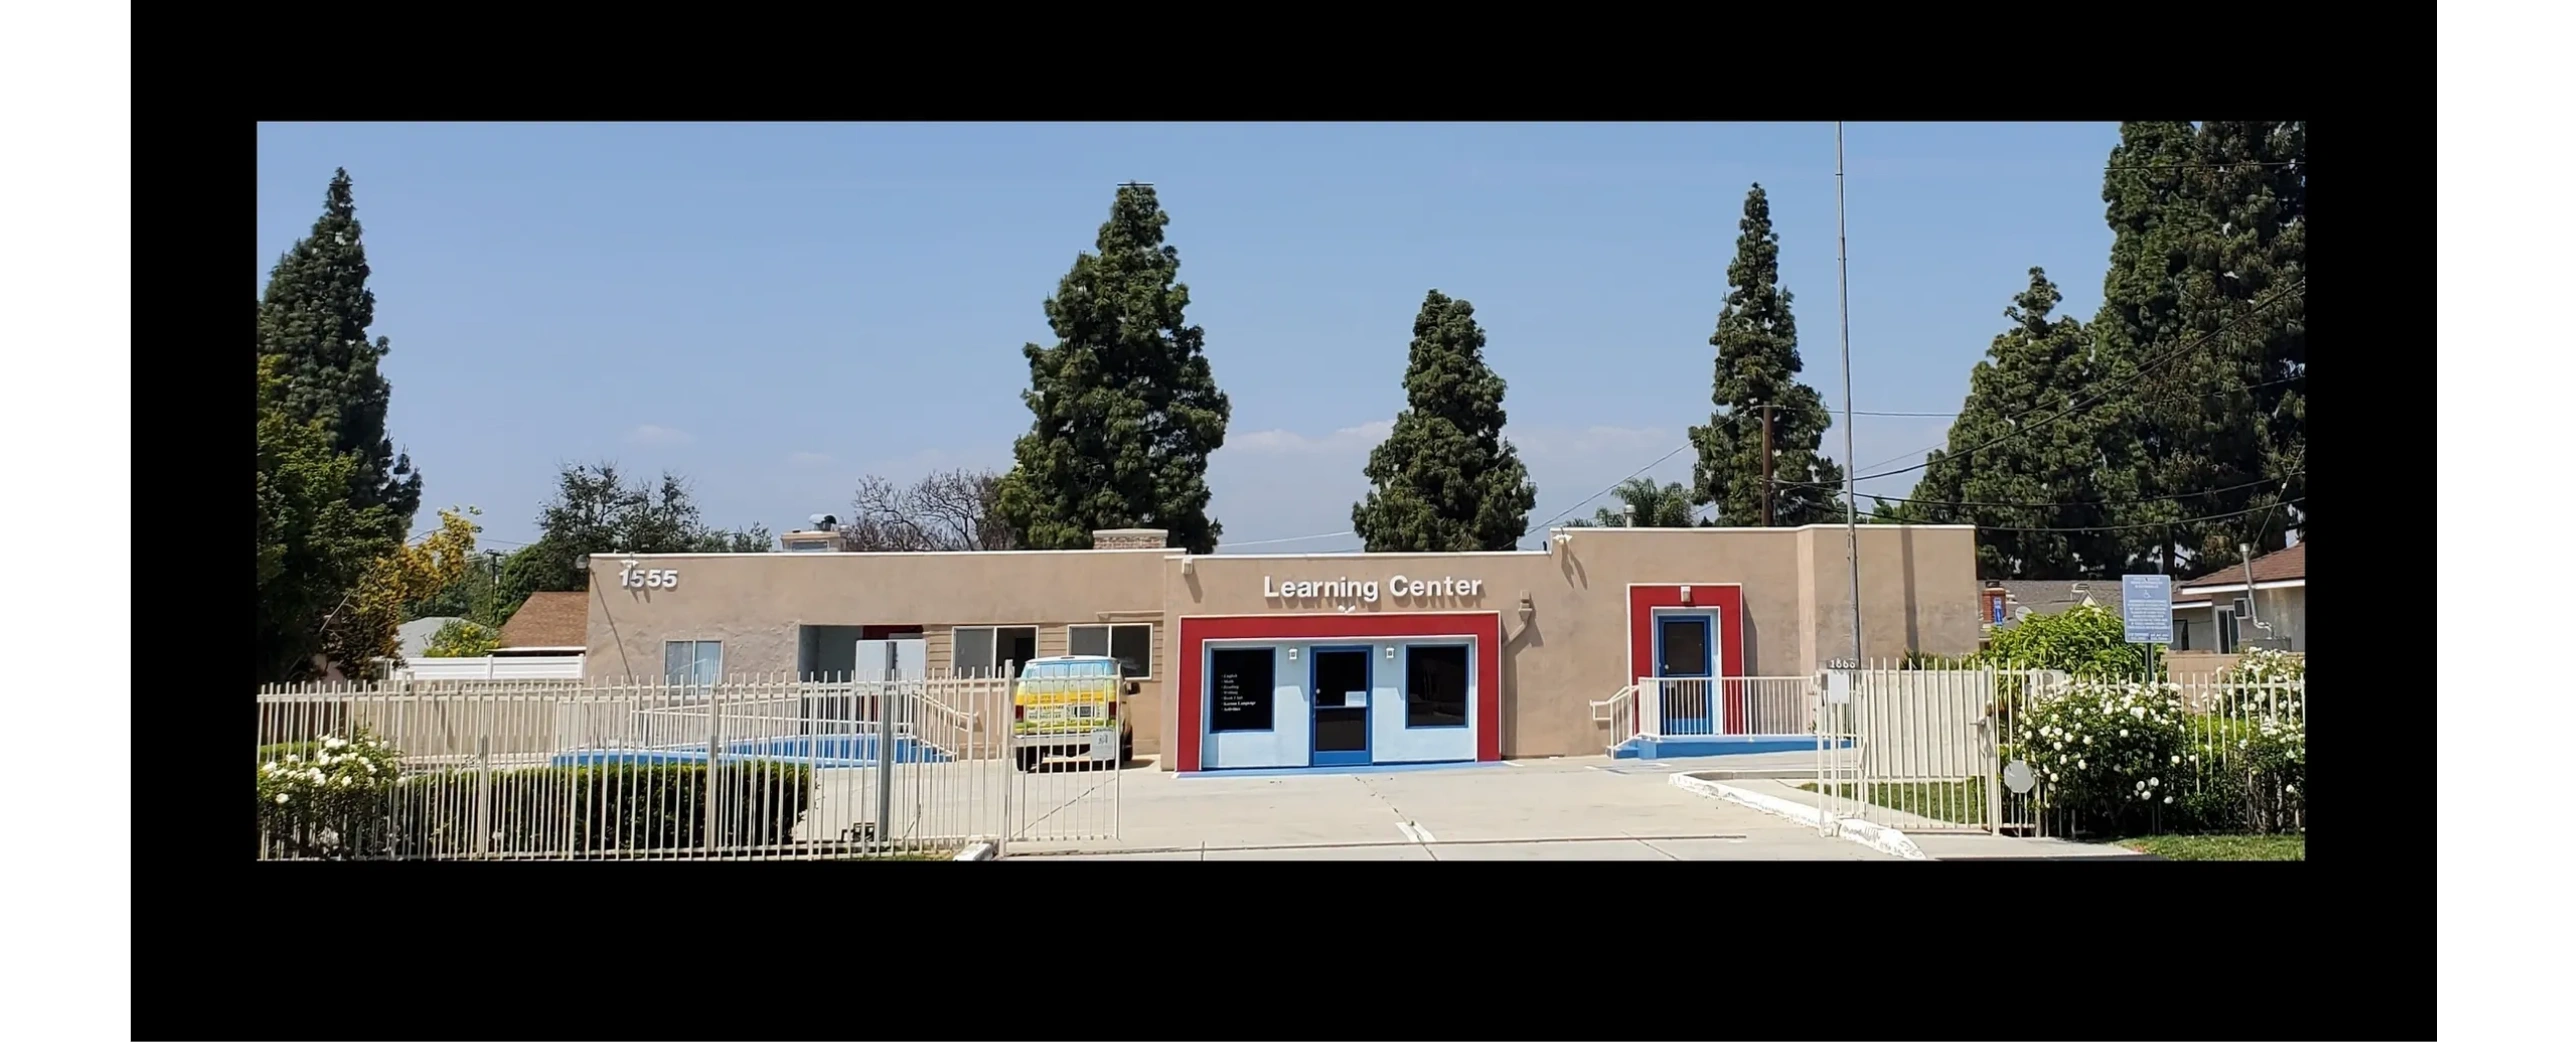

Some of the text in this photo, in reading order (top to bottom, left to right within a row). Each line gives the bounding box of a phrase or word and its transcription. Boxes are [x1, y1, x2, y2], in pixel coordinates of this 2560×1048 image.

[618, 569, 678, 588] 1555
[1264, 575, 1482, 602] Learning Center
